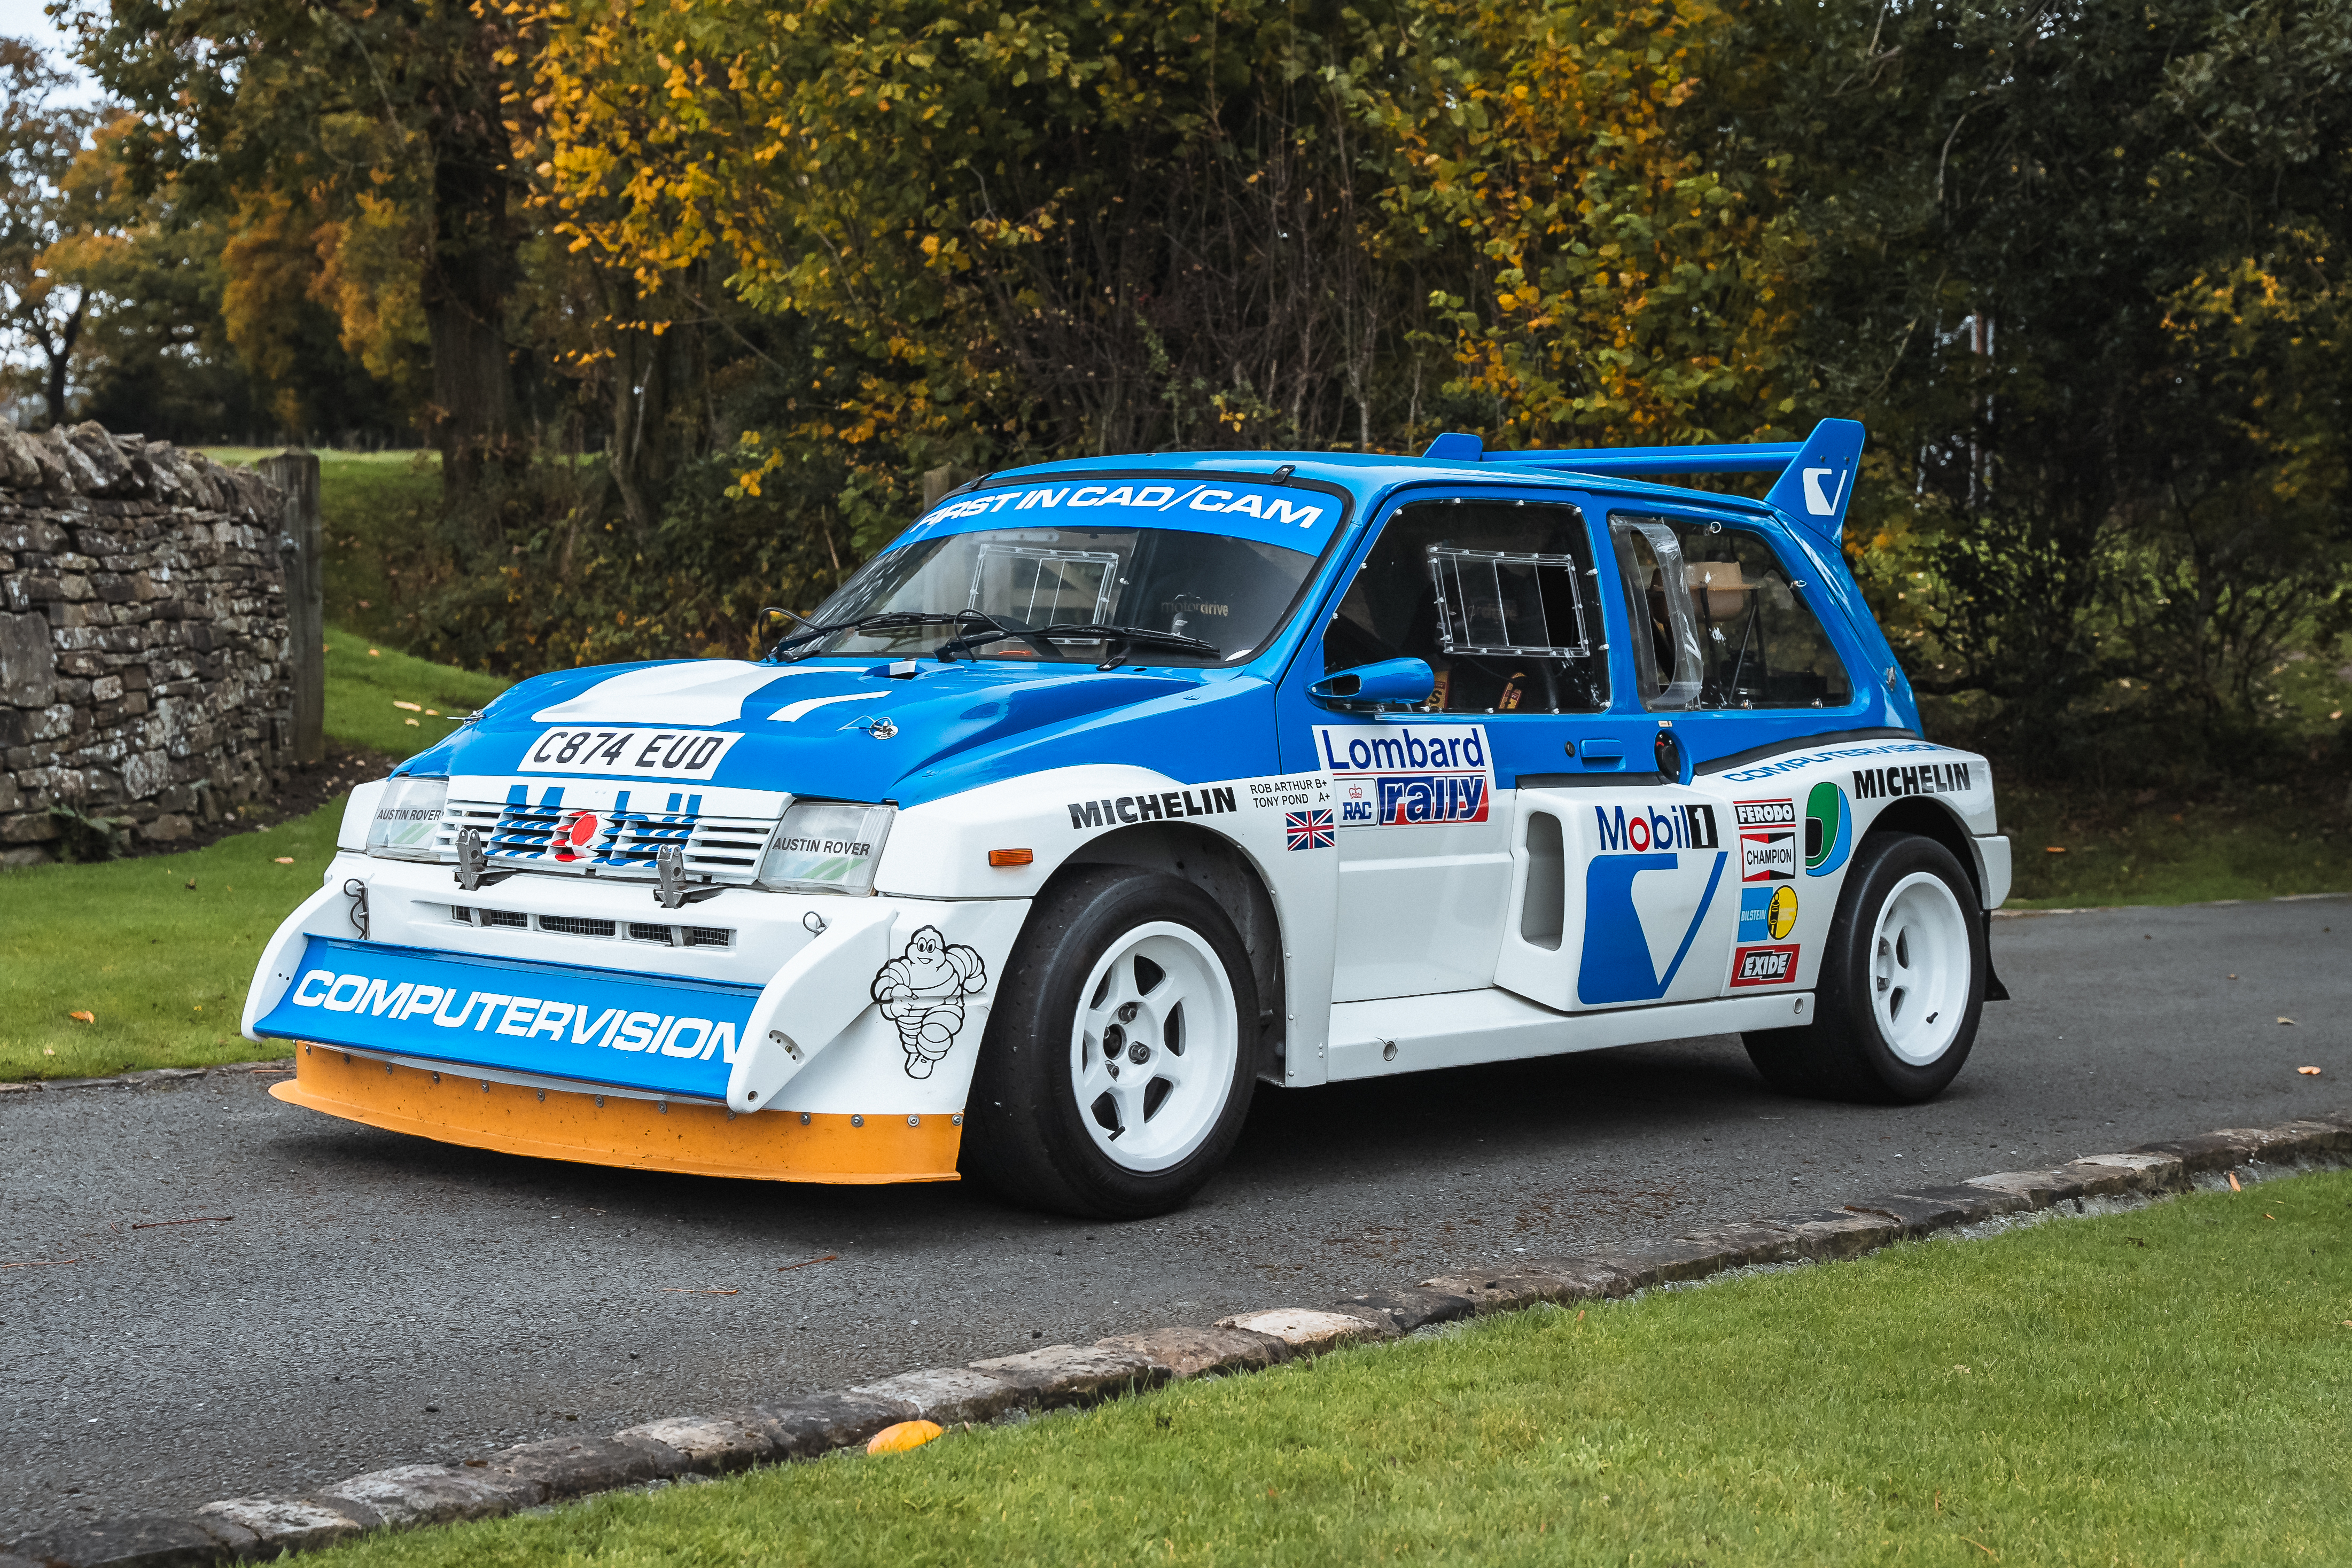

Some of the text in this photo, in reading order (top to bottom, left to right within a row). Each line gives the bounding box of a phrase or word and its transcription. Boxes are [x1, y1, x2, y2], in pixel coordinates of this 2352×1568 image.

[909, 484, 1323, 533] FIRST IN CAD/CAM
[534, 732, 724, 770] C874 EUD
[1321, 728, 1485, 770] Lombard
[1250, 778, 1327, 794] ROB ARTHUR B+
[1852, 762, 1972, 800] MICHELIN
[1068, 786, 1237, 829] MICHELIN
[1252, 792, 1330, 808] TONY POND A+
[1342, 776, 1486, 823] RAC rally
[377, 809, 442, 821] AUSTIN ROVER
[1737, 804, 1793, 823] FERODO
[772, 837, 870, 856] AUSTIN ROVER
[1746, 848, 1792, 865] CHAMPION
[1741, 908, 1767, 922] BILSTEIN
[1744, 954, 1788, 977] EXIDE
[292, 970, 736, 1065] COMPUTERVISION
